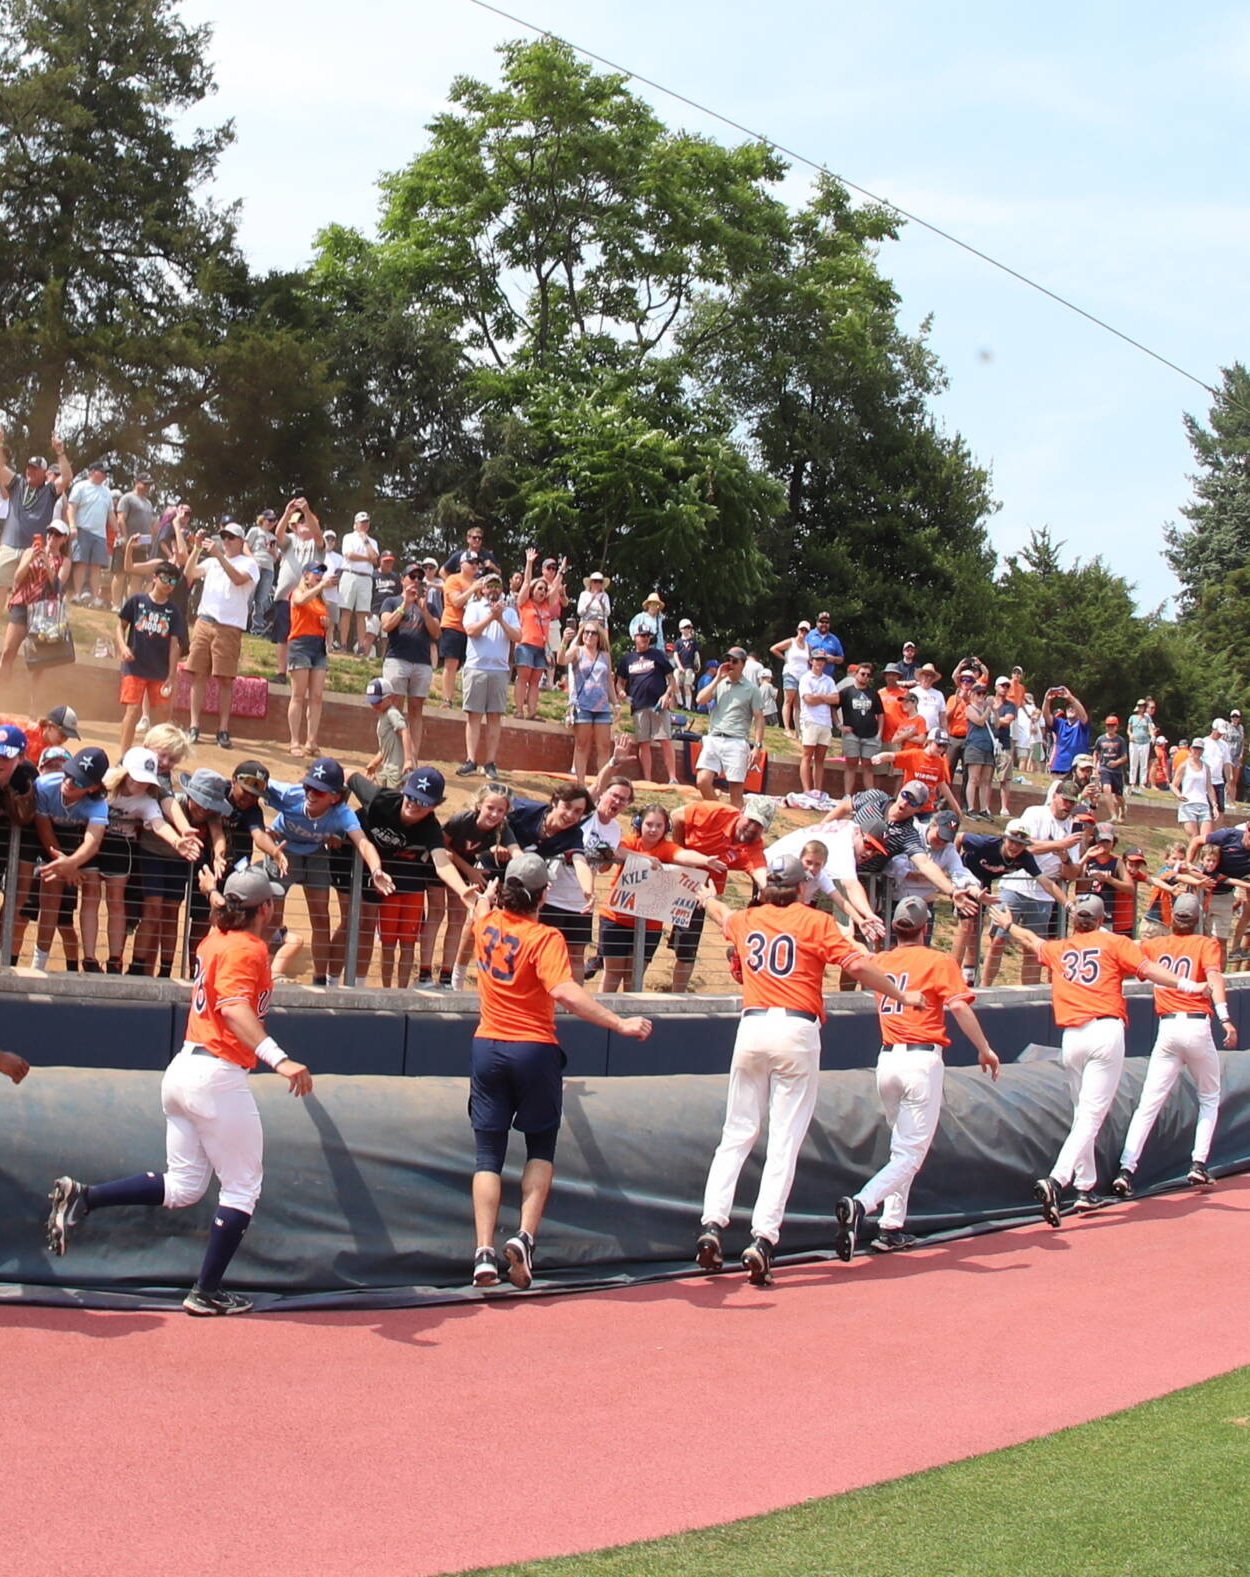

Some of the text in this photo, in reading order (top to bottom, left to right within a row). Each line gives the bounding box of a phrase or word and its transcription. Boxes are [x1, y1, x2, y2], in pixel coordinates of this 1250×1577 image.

[621, 869, 648, 886] KYLE
[609, 888, 636, 910] UVA
[477, 925, 521, 981] 33
[745, 932, 797, 977] 30
[1061, 947, 1101, 985] 35
